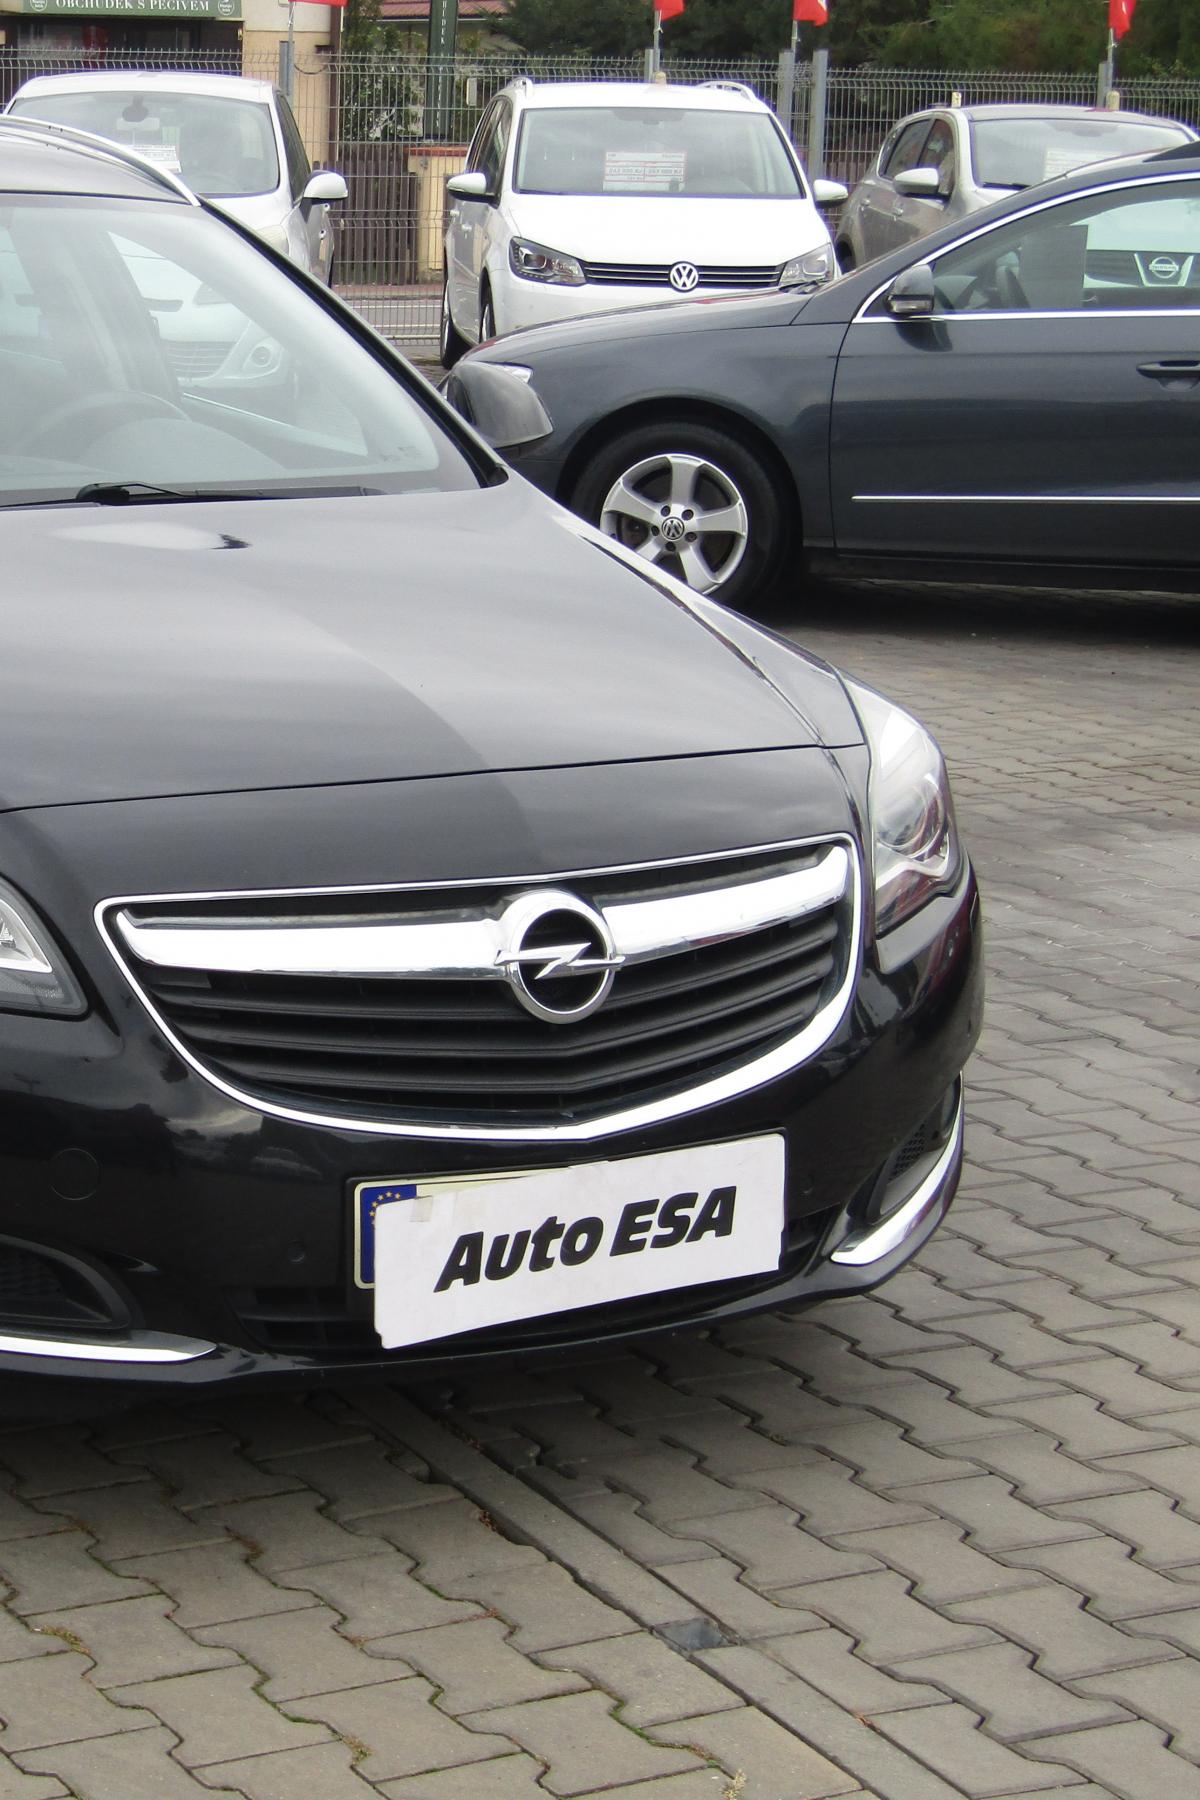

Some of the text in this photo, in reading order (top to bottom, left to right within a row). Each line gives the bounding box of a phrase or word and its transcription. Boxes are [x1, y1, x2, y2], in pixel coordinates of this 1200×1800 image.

[670, 262, 699, 291] VW
[433, 1186, 737, 1293] Auto ESA
